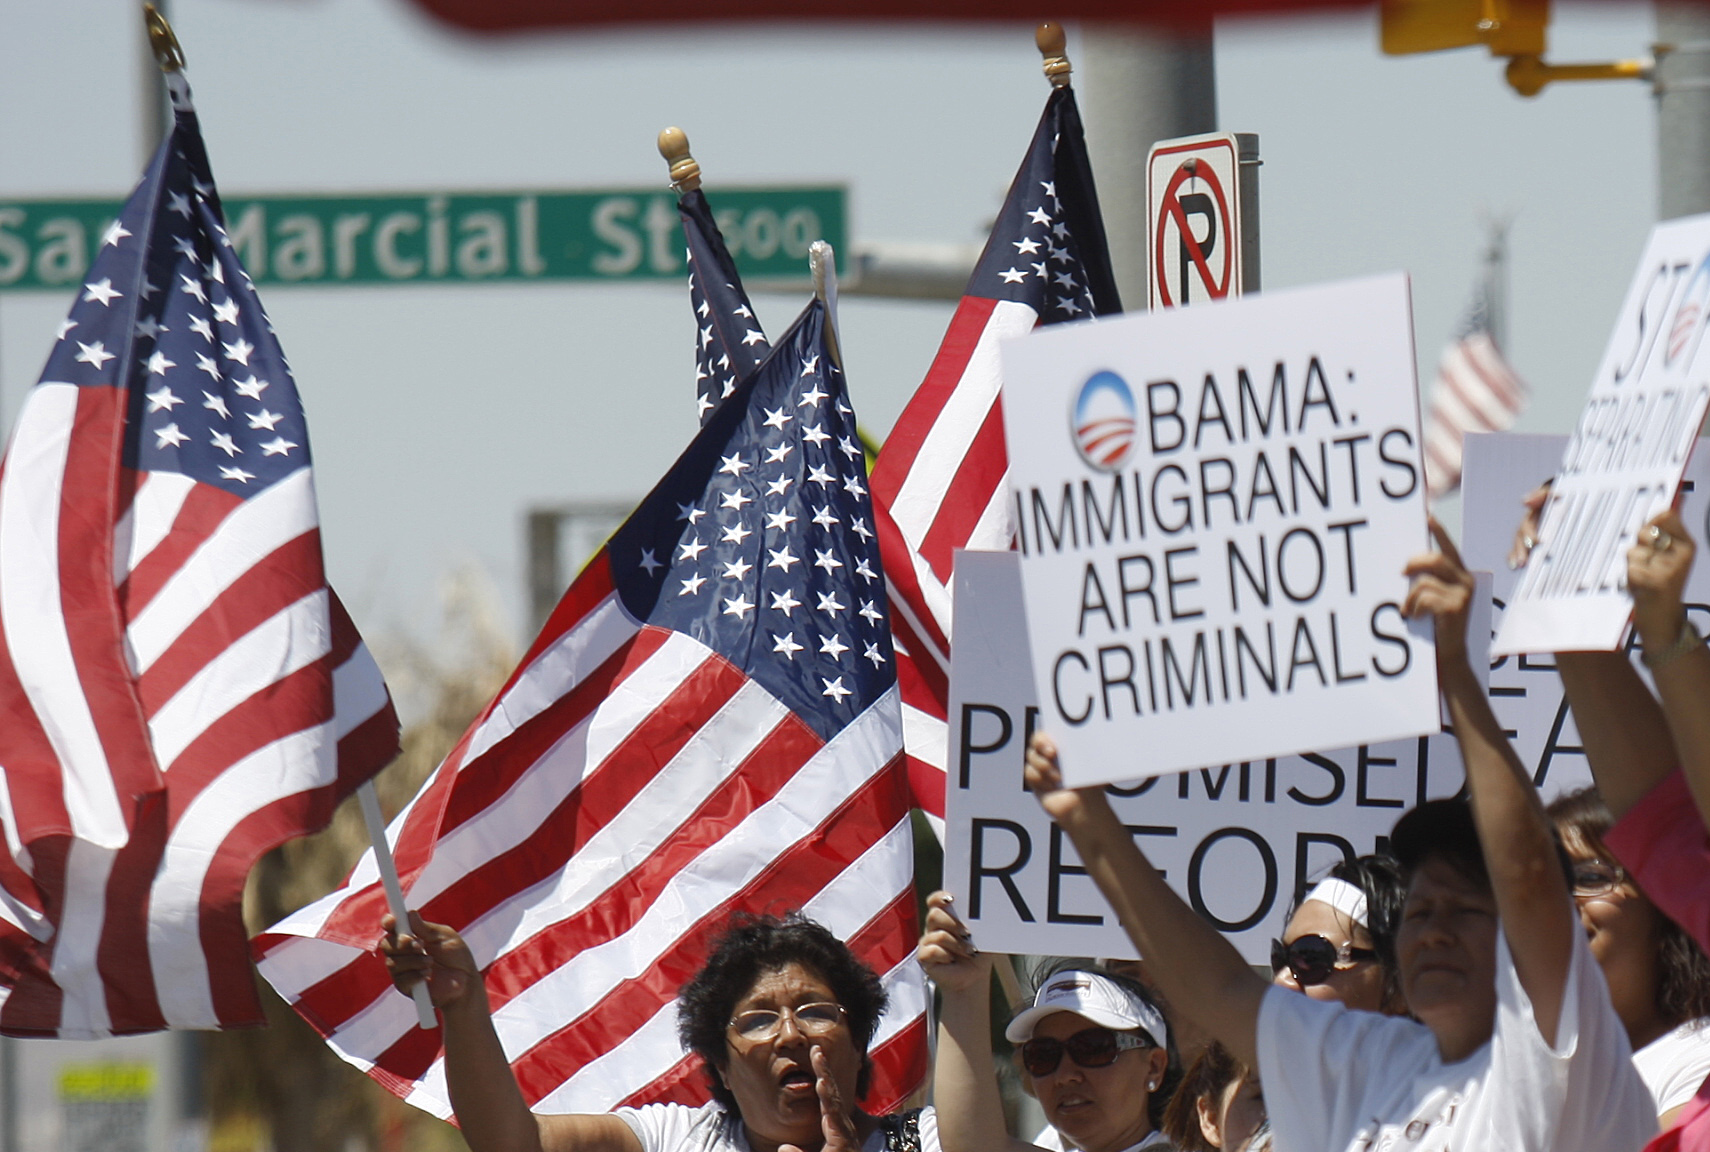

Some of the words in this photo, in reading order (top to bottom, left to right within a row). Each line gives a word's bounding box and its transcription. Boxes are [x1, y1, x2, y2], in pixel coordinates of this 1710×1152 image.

[592, 196, 681, 274] St
[1014, 427, 1418, 559] IMMIGRANTS
[1077, 545, 1205, 637] ARE
[1226, 517, 1371, 613] NOT
[1051, 600, 1412, 727] CRIMINALS
